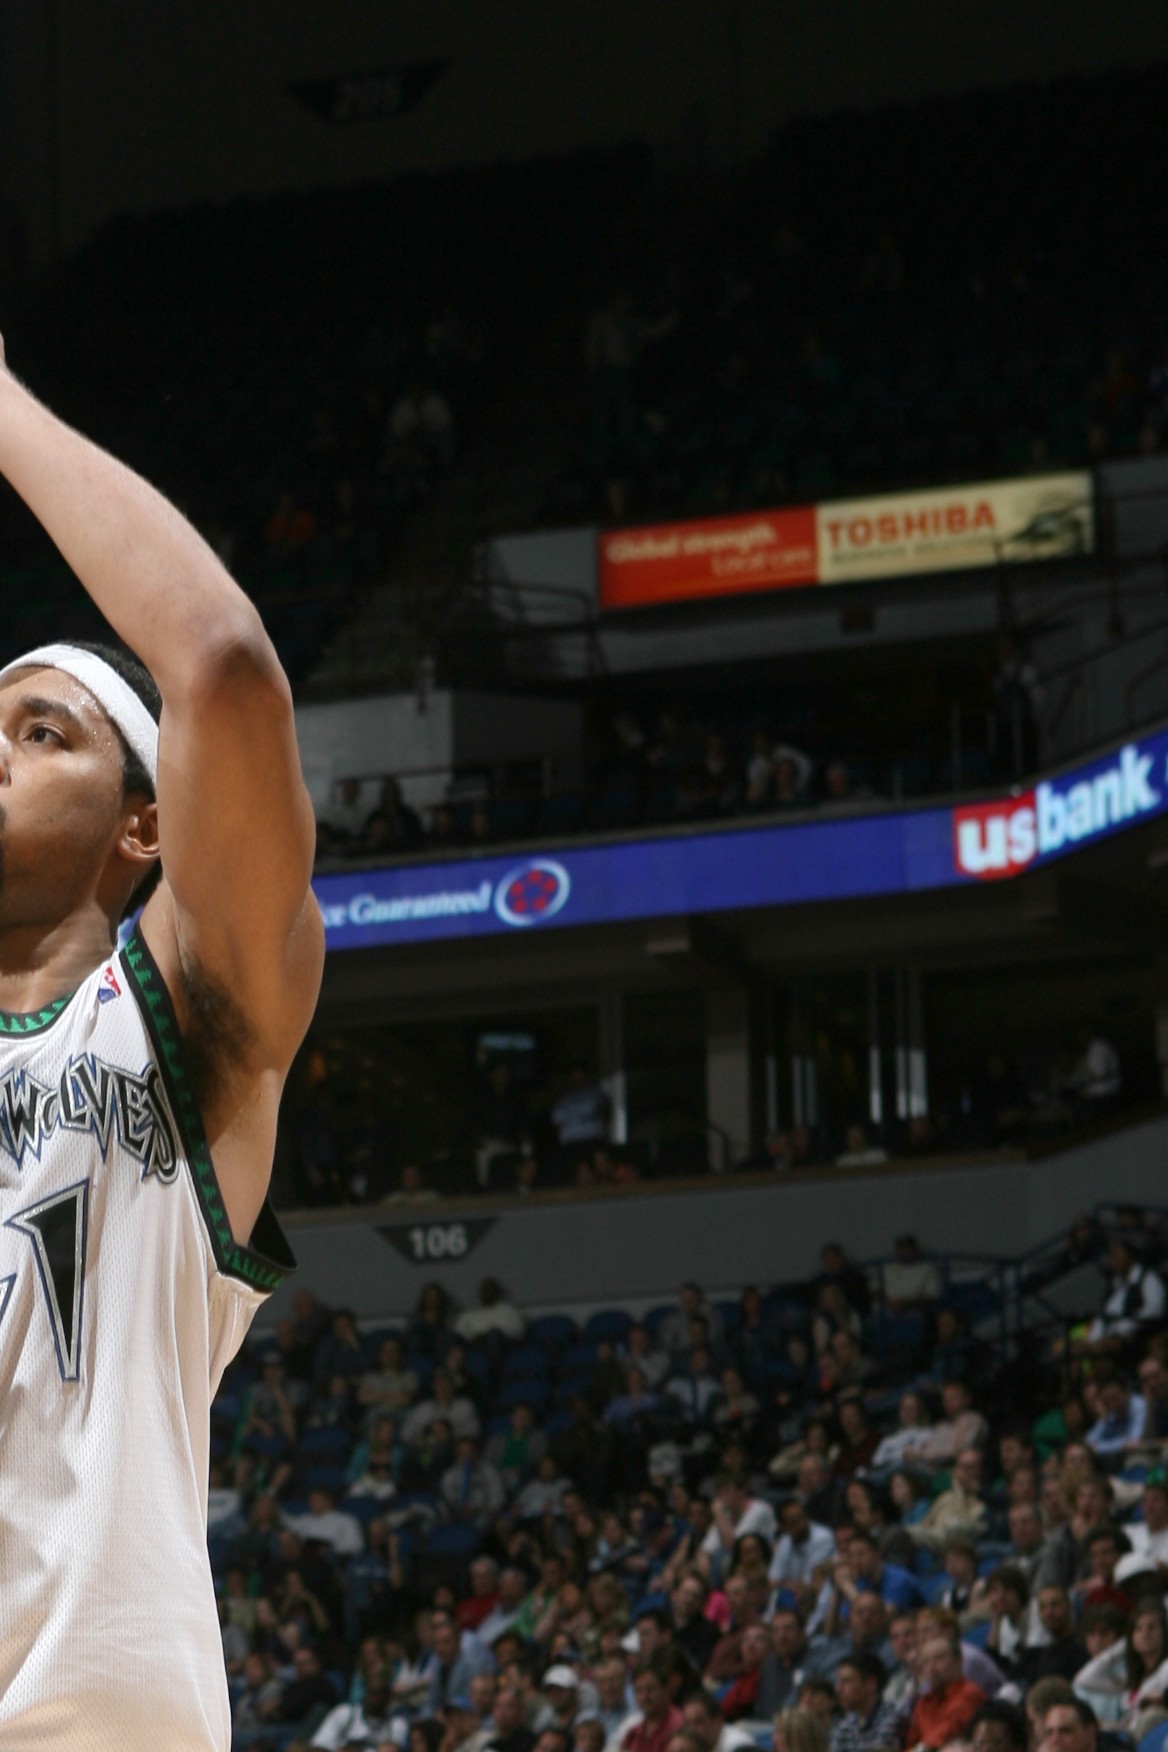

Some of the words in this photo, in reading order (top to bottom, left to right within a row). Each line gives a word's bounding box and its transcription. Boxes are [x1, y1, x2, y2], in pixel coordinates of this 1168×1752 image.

[827, 498, 995, 548] TOSHIBA
[348, 880, 492, 926] Guaranteed
[409, 1224, 468, 1260] 106
